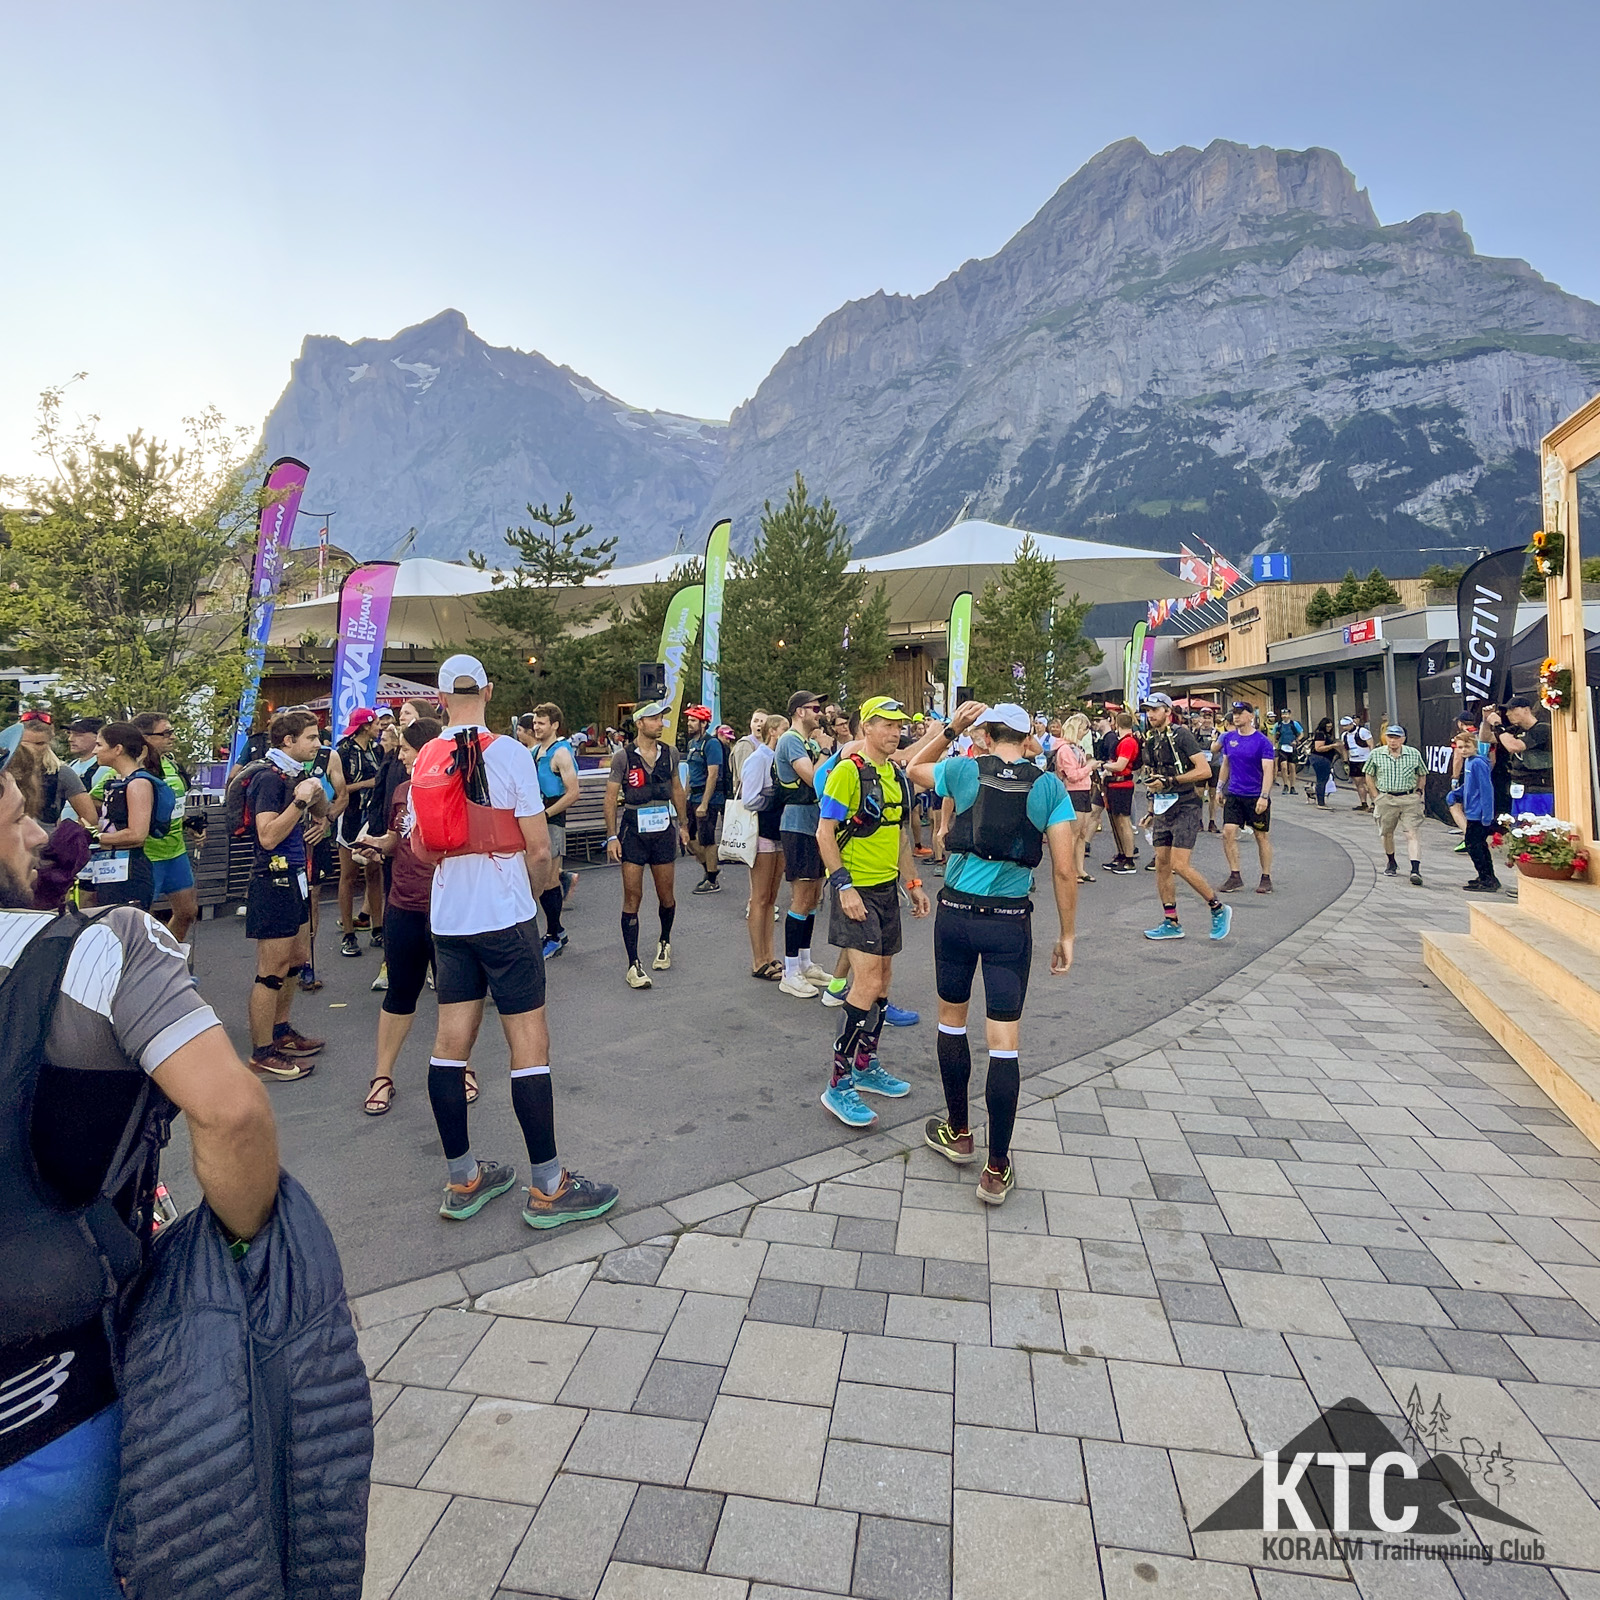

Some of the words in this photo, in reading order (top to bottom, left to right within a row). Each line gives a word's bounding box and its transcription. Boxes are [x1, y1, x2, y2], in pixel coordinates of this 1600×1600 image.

[347, 616, 358, 638] FLY
[357, 593, 373, 640] HUMAN
[367, 621, 378, 641] FLY
[1426, 745, 1452, 774] VECT
